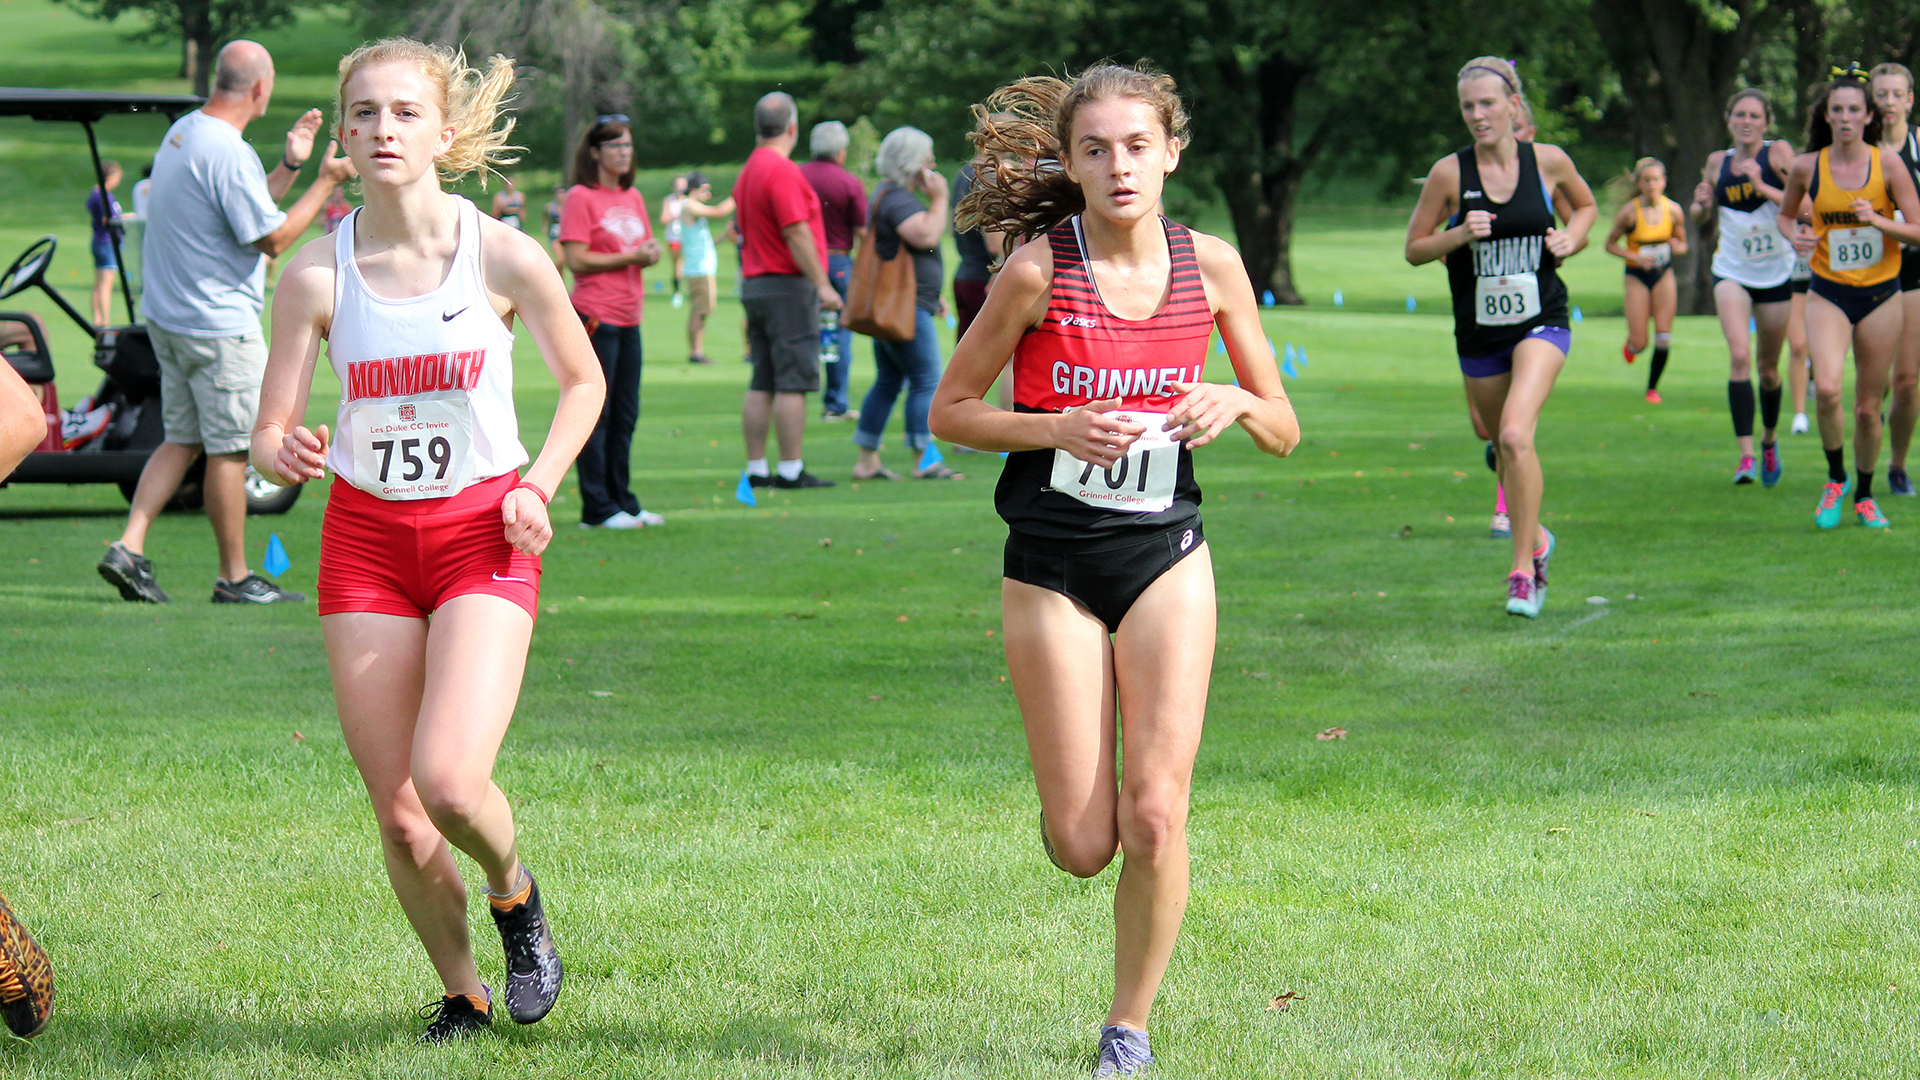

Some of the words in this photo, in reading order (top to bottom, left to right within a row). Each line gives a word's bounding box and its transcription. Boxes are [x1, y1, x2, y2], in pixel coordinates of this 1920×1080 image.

[1725, 182, 1762, 202] WP
[1742, 235, 1774, 255] 922
[1838, 242, 1873, 262] 830
[1468, 235, 1543, 276] TRUMAN
[1485, 293, 1525, 315] 803
[347, 347, 487, 402] MONMOUTH
[370, 426, 384, 434] Les
[386, 423, 408, 433] Duke
[410, 423, 424, 431] CC
[426, 421, 450, 430] Invite
[1137, 434, 1160, 442] nvite
[371, 436, 452, 483] 759
[382, 485, 416, 495] Grinnell
[418, 483, 450, 493] College
[1079, 489, 1113, 501] Grinnell
[1115, 494, 1146, 505] College
